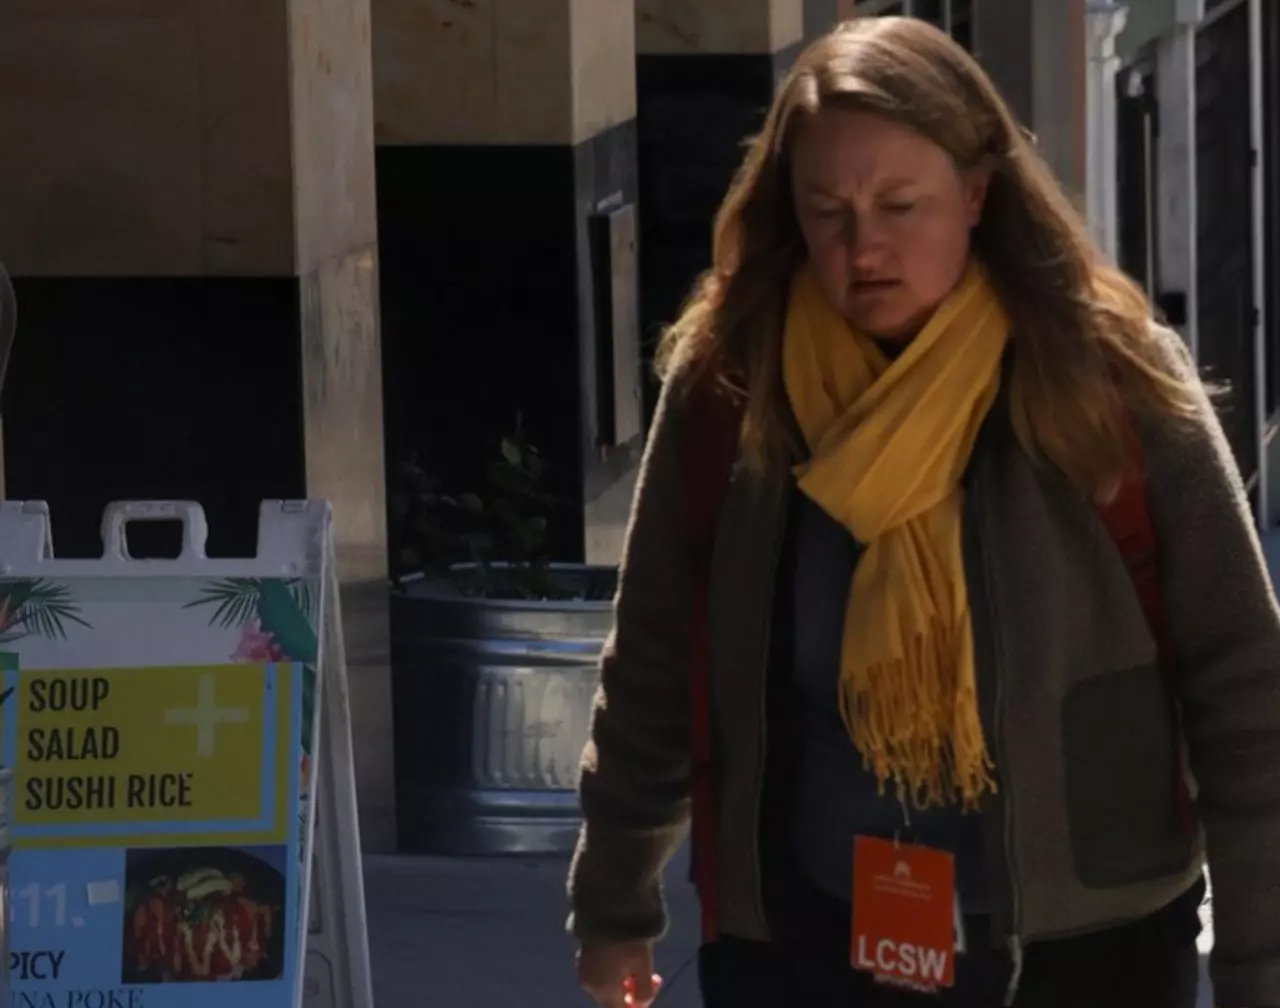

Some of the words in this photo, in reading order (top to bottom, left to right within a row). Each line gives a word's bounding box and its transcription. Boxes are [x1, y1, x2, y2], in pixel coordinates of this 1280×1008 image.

[29, 677, 110, 713] SOUP
[27, 726, 120, 762] SALAD
[25, 774, 116, 810] SUSHI
[127, 772, 193, 808] RICE
[10, 882, 85, 928] 11.
[858, 934, 947, 982] LCSW
